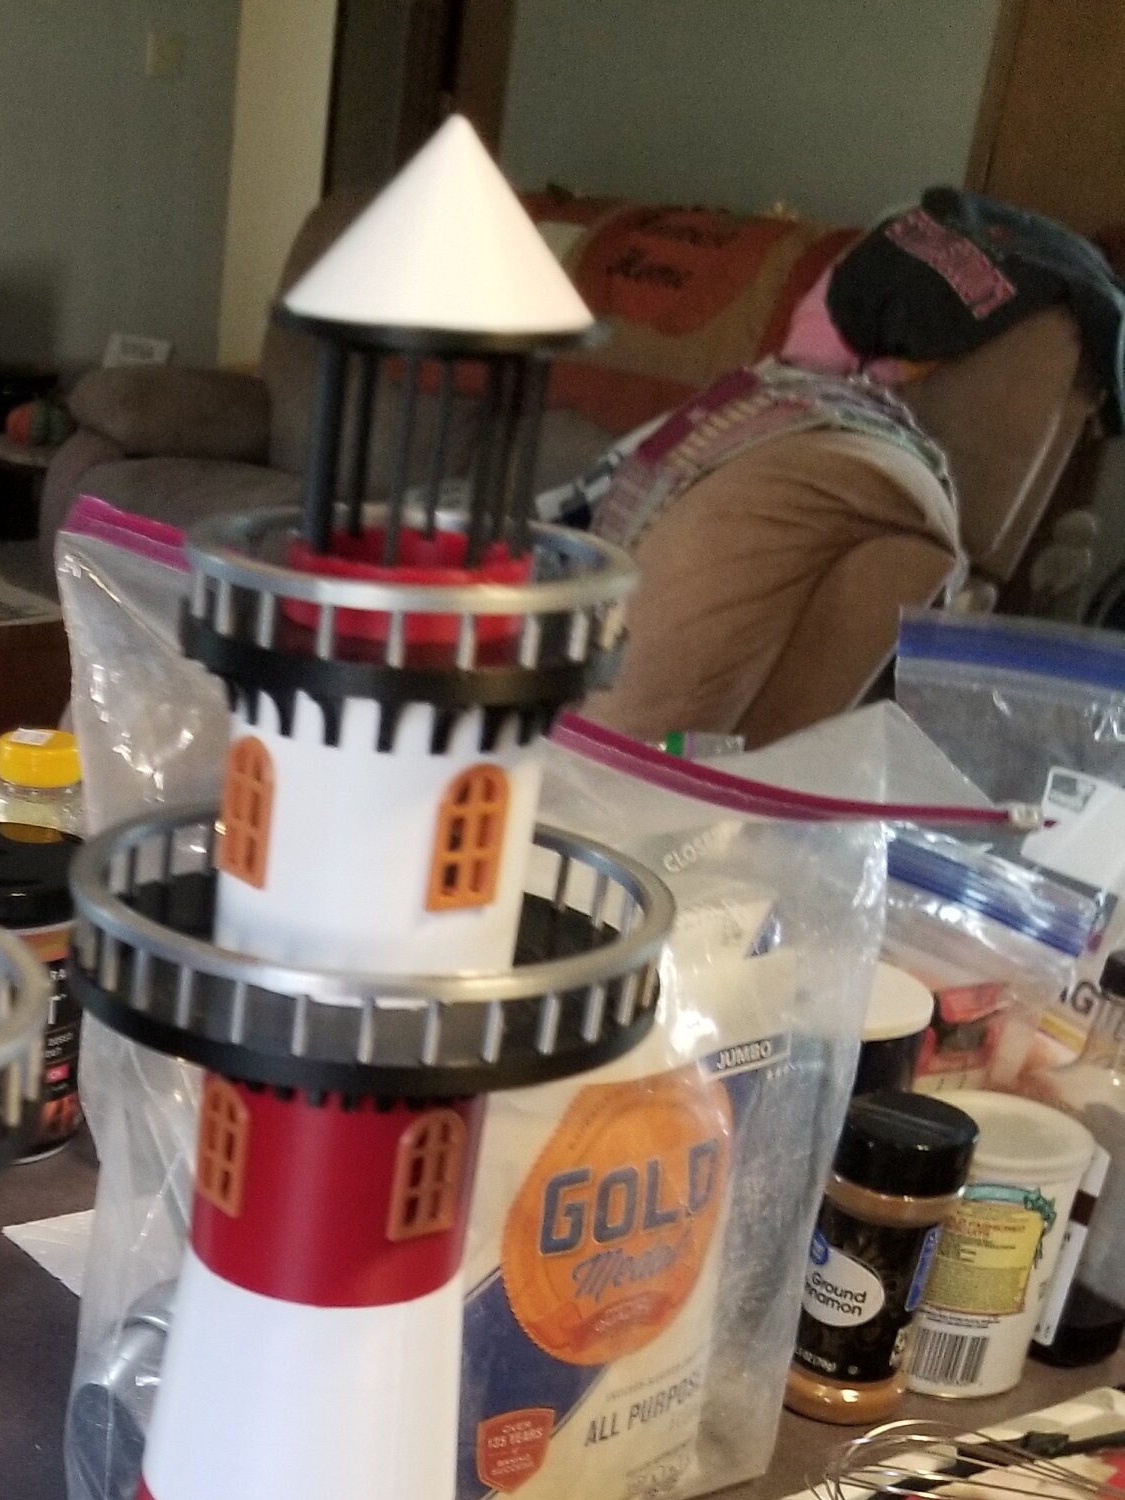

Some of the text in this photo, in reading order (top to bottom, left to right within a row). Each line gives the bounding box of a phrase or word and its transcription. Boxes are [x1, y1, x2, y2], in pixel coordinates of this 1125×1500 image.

[717, 1040, 772, 1070] JUMBO
[539, 1138, 721, 1256] GOLD
[804, 1280, 863, 1317] nnamon
[812, 1271, 867, 1303] Ground
[584, 1412, 620, 1447] ALL
